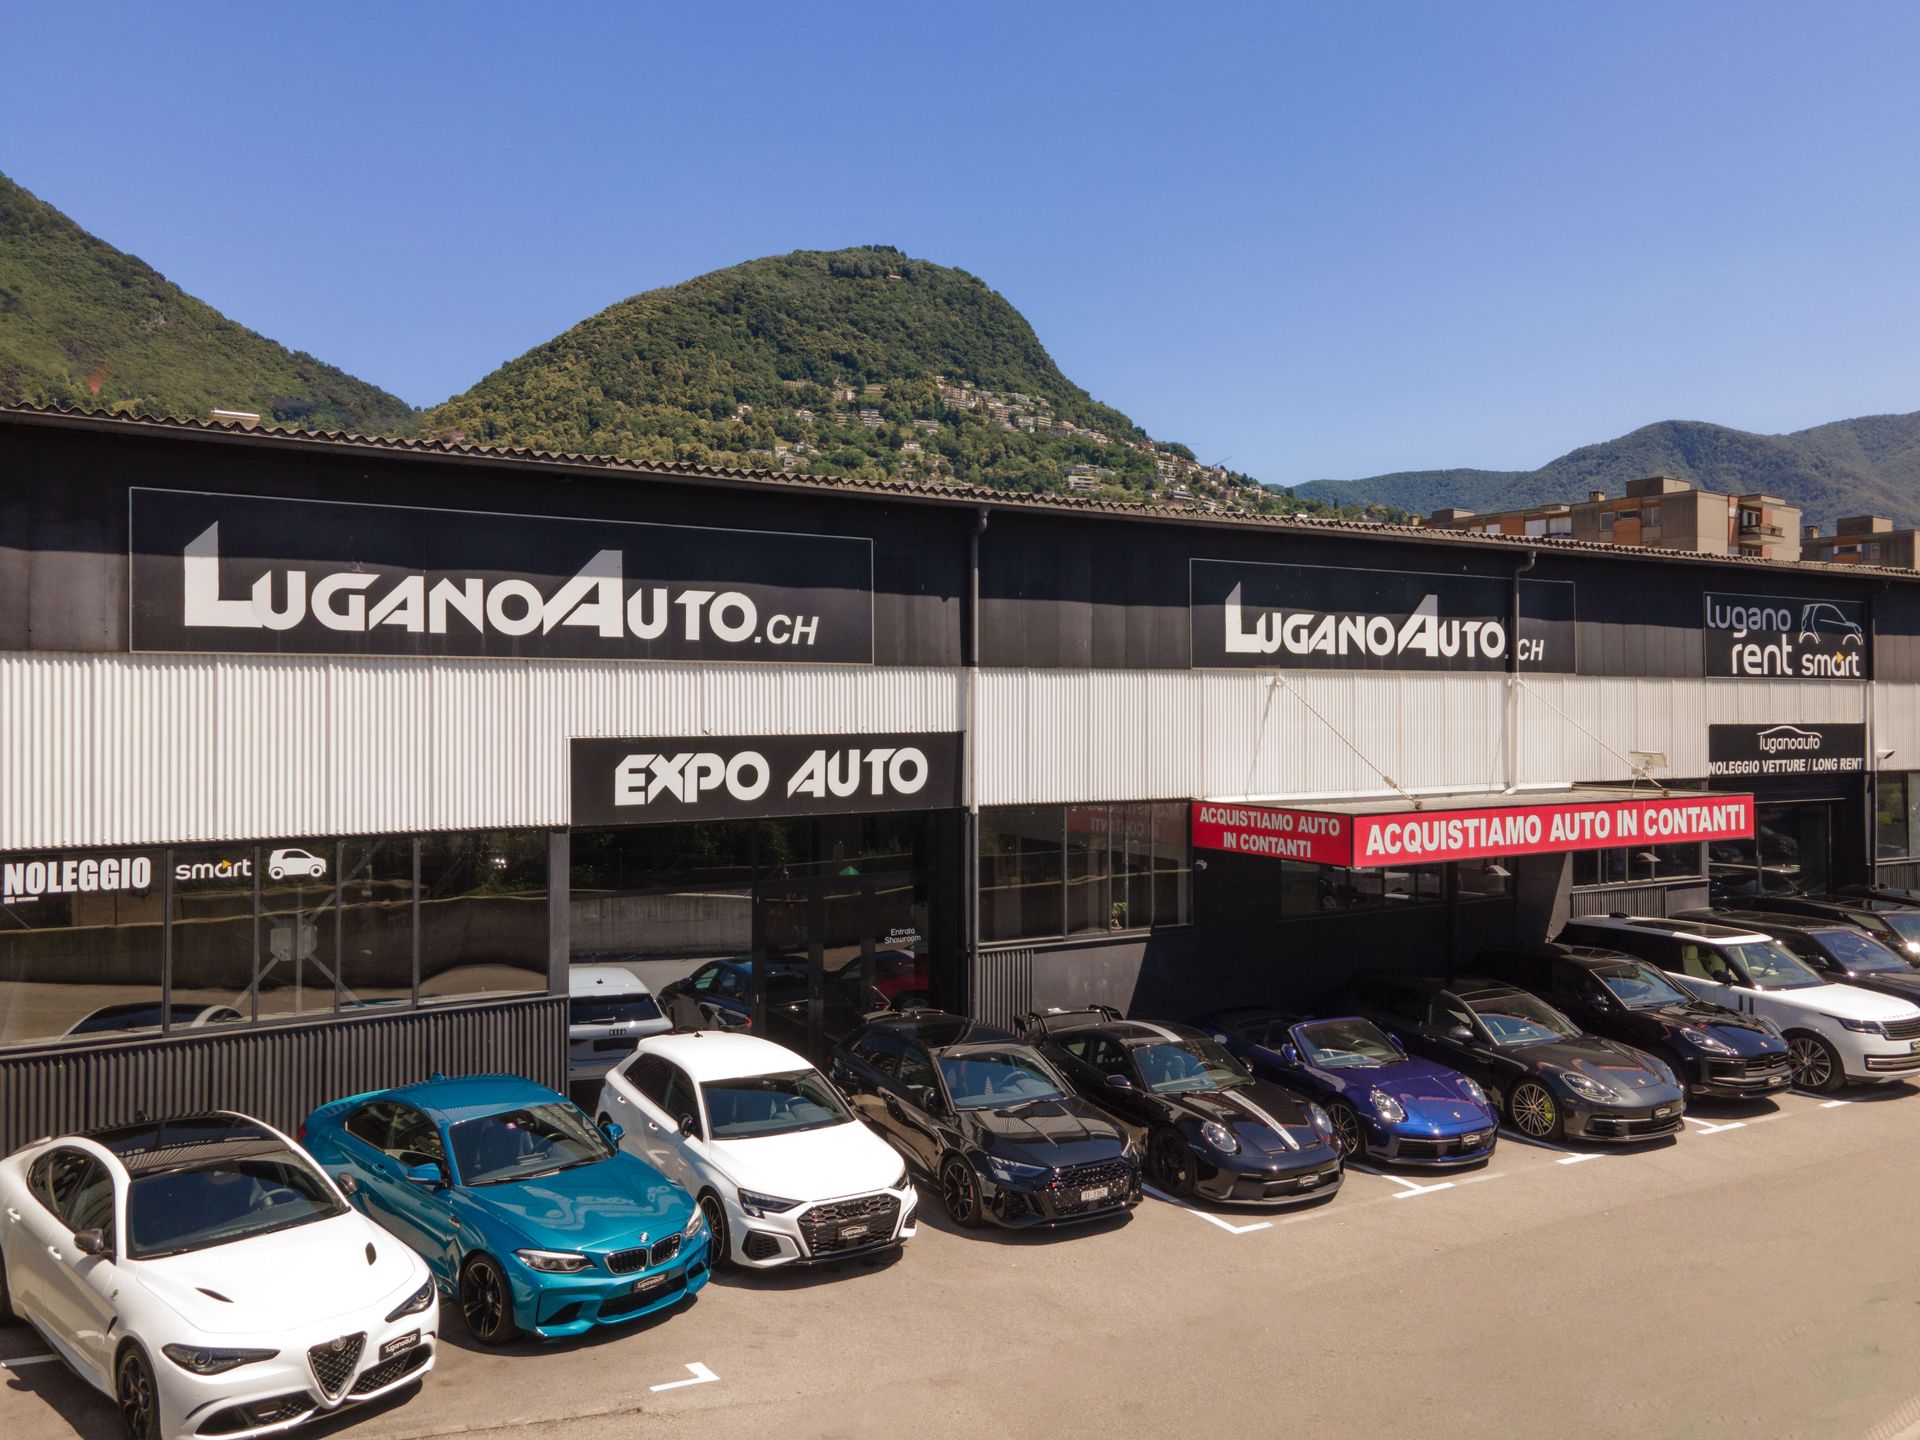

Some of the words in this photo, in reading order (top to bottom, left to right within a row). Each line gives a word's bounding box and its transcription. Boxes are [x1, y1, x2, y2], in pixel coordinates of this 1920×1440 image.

[1706, 596, 1792, 638] lugano
[1732, 634, 1793, 676] rent
[1801, 651, 1861, 677] smart
[1760, 735, 1820, 754] luganoauto
[614, 751, 770, 806] EXPO
[787, 747, 928, 798] AUTO
[1709, 760, 1760, 776] NOLEGGIO
[1762, 758, 1805, 773] VETTURE
[1813, 758, 1838, 772] LONG
[1840, 757, 1864, 771] RENT
[1200, 806, 1293, 831] ACQUISTIAMO
[1297, 815, 1340, 837] AUTO
[1366, 814, 1542, 856] ACQUISTIAMO
[1550, 811, 1610, 842] AUTO
[1617, 808, 1637, 837] IN
[1644, 804, 1745, 836] CONTANTI
[1223, 831, 1237, 849] IN
[1240, 834, 1311, 858] CONTANTI
[4, 857, 151, 896] NOLEGGIO
[175, 858, 252, 881] smart
[884, 935, 921, 944] Showroom
[890, 928, 915, 936] Entrata
